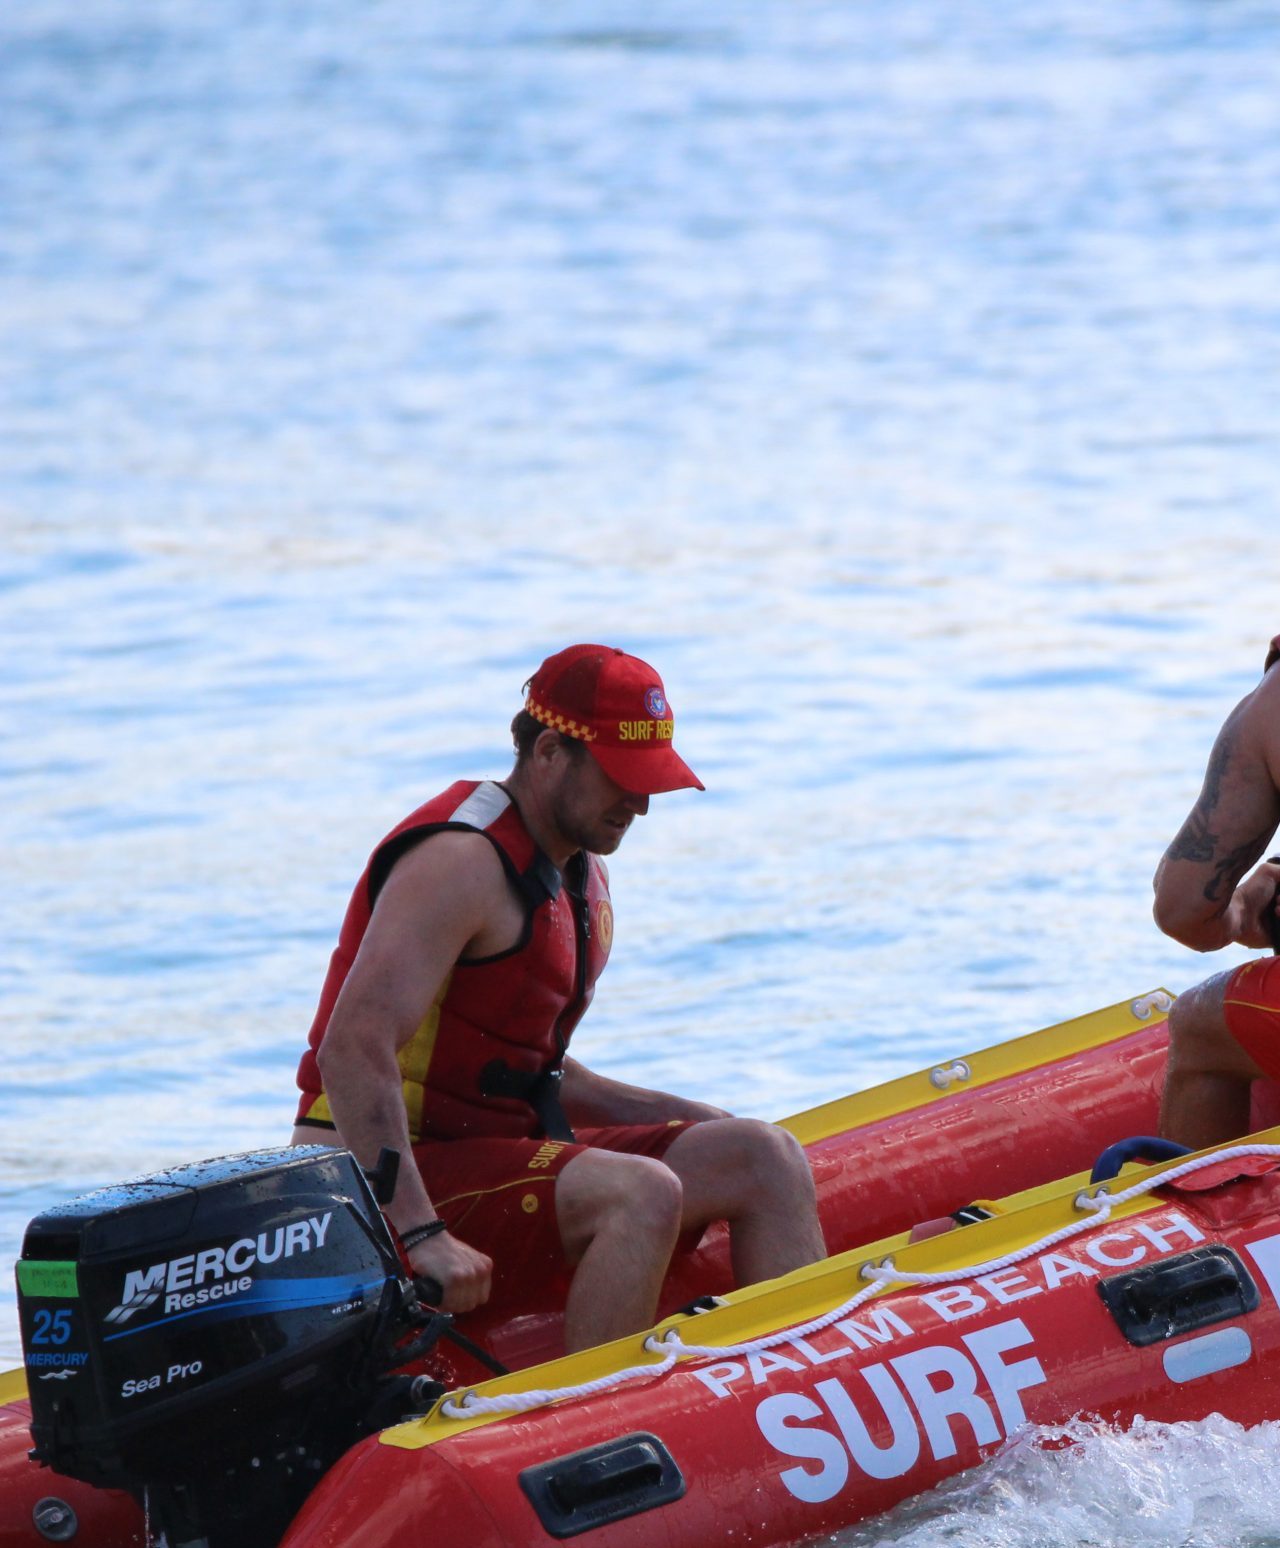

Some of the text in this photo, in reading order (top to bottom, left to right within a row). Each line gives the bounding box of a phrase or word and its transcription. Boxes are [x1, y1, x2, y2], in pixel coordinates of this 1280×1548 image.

[619, 721, 654, 740] SURF
[528, 1142, 564, 1168] SURF
[121, 1212, 332, 1305] MERCURY
[164, 1275, 252, 1314] Rescue
[697, 1308, 914, 1398] PALM
[920, 1213, 1206, 1322] BEACH
[32, 1309, 72, 1345] 25
[26, 1353, 88, 1366] MERCURY
[121, 1360, 202, 1398] Sea Pro
[755, 1318, 1047, 1503] SURF
